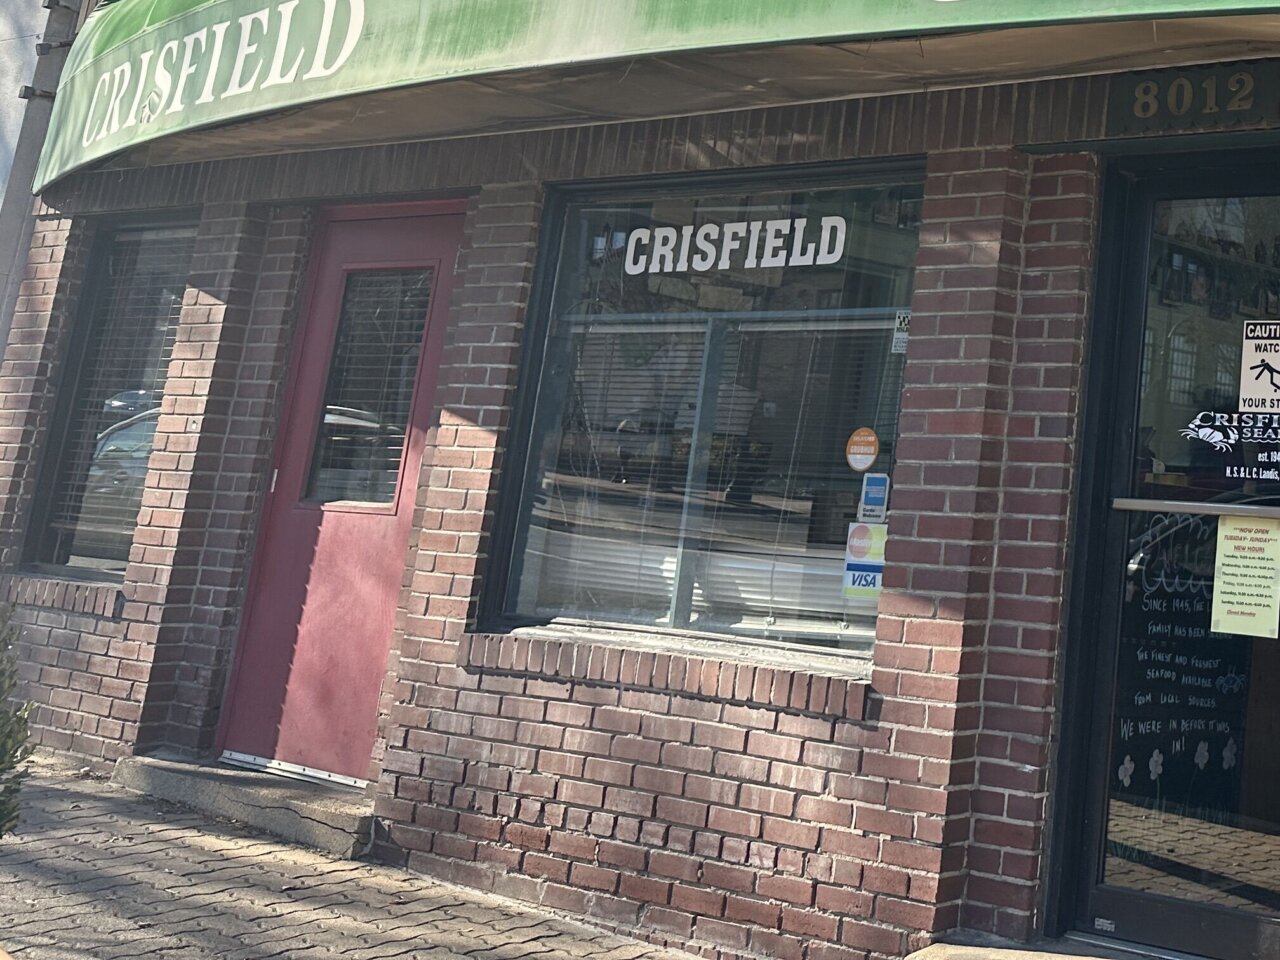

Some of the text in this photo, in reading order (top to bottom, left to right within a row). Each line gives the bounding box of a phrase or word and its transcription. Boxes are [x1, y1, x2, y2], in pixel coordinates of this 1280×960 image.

[1133, 71, 1255, 119] 8012
[624, 216, 846, 275] CRISFIELD
[1242, 397, 1267, 409] YOUR
[1257, 452, 1269, 462] est.
[851, 573, 877, 587] VISA
[1142, 592, 1167, 612] SINCE
[1120, 717, 1134, 740] WE
[1138, 719, 1162, 734] WERE
